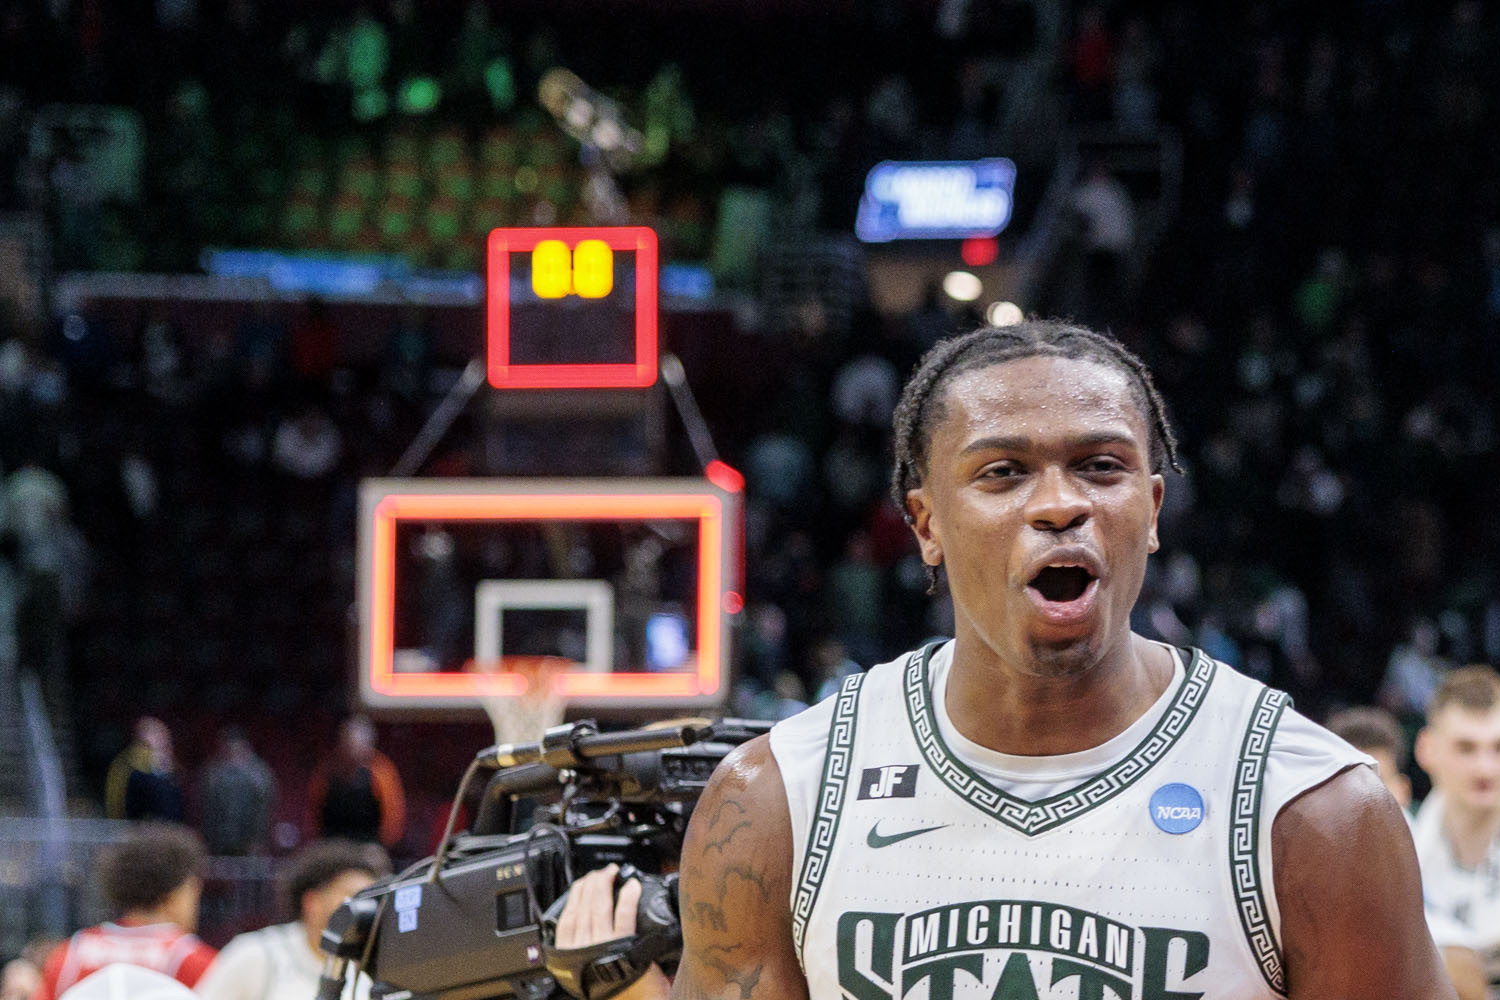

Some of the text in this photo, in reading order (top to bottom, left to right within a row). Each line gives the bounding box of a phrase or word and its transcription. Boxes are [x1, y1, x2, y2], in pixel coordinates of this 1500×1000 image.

[869, 766, 908, 798] JF
[1157, 806, 1201, 820] NCAA
[909, 904, 1128, 970] MICHIGAN
